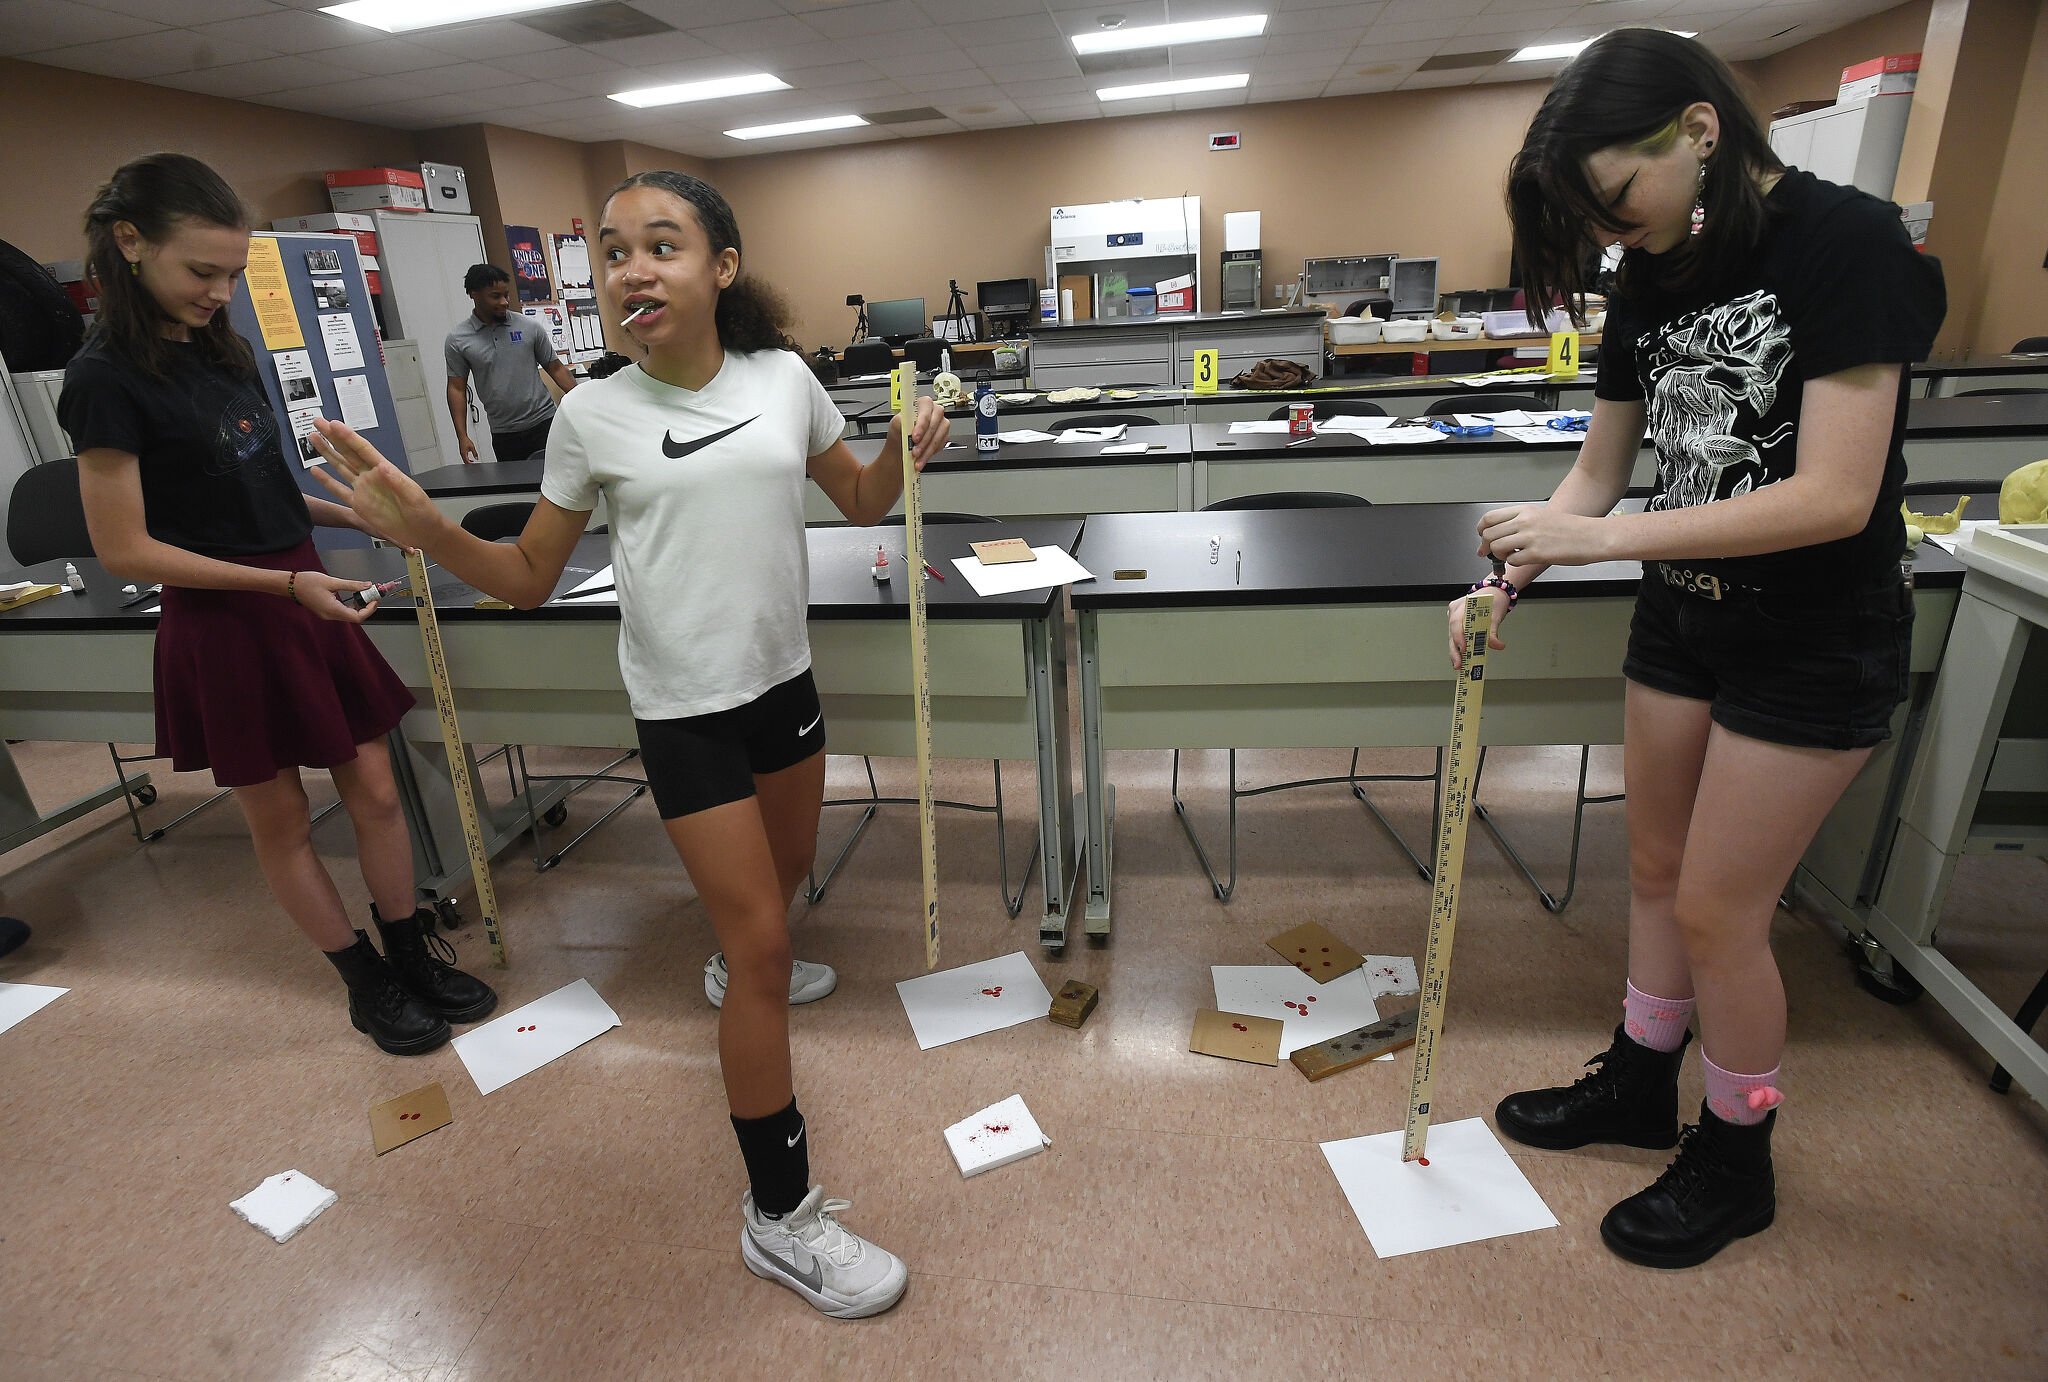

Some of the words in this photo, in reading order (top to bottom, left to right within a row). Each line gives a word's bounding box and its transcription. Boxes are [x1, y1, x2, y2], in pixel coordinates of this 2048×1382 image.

[511, 249, 542, 262] UNITED
[1560, 337, 1571, 365] 4
[1200, 354, 1211, 381] 3
